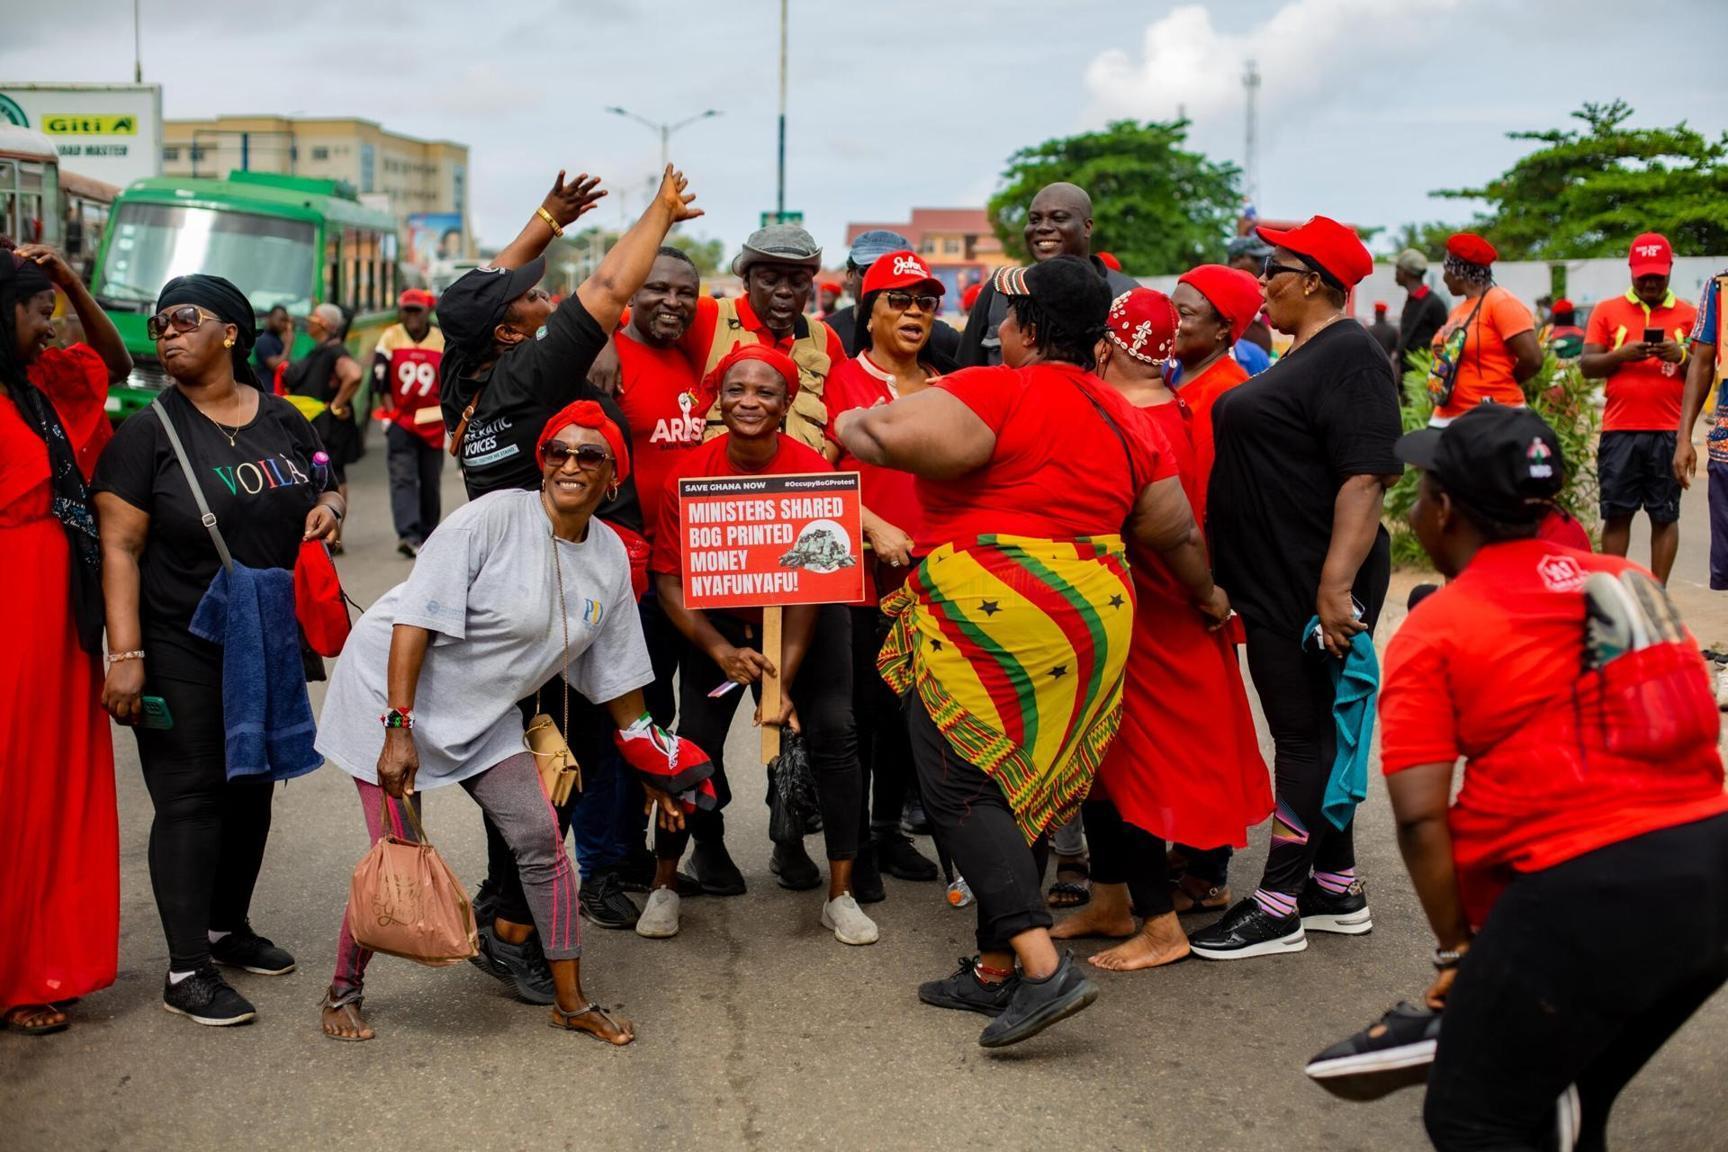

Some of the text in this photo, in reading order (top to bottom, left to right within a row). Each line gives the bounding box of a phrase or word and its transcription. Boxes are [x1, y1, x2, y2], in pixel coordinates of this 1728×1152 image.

[49, 118, 101, 132] Giti
[398, 361, 436, 397] 99
[465, 435, 497, 456] VOICES
[685, 481, 766, 492] SAVE GHANA NOW
[784, 479, 855, 487] #OccupyBoGProtest
[688, 497, 843, 523] MINISTERS SHARED
[689, 524, 794, 548] BOG PRINTED
[690, 550, 748, 572] MONEY
[691, 572, 799, 597] NYAFUNYAFU!
